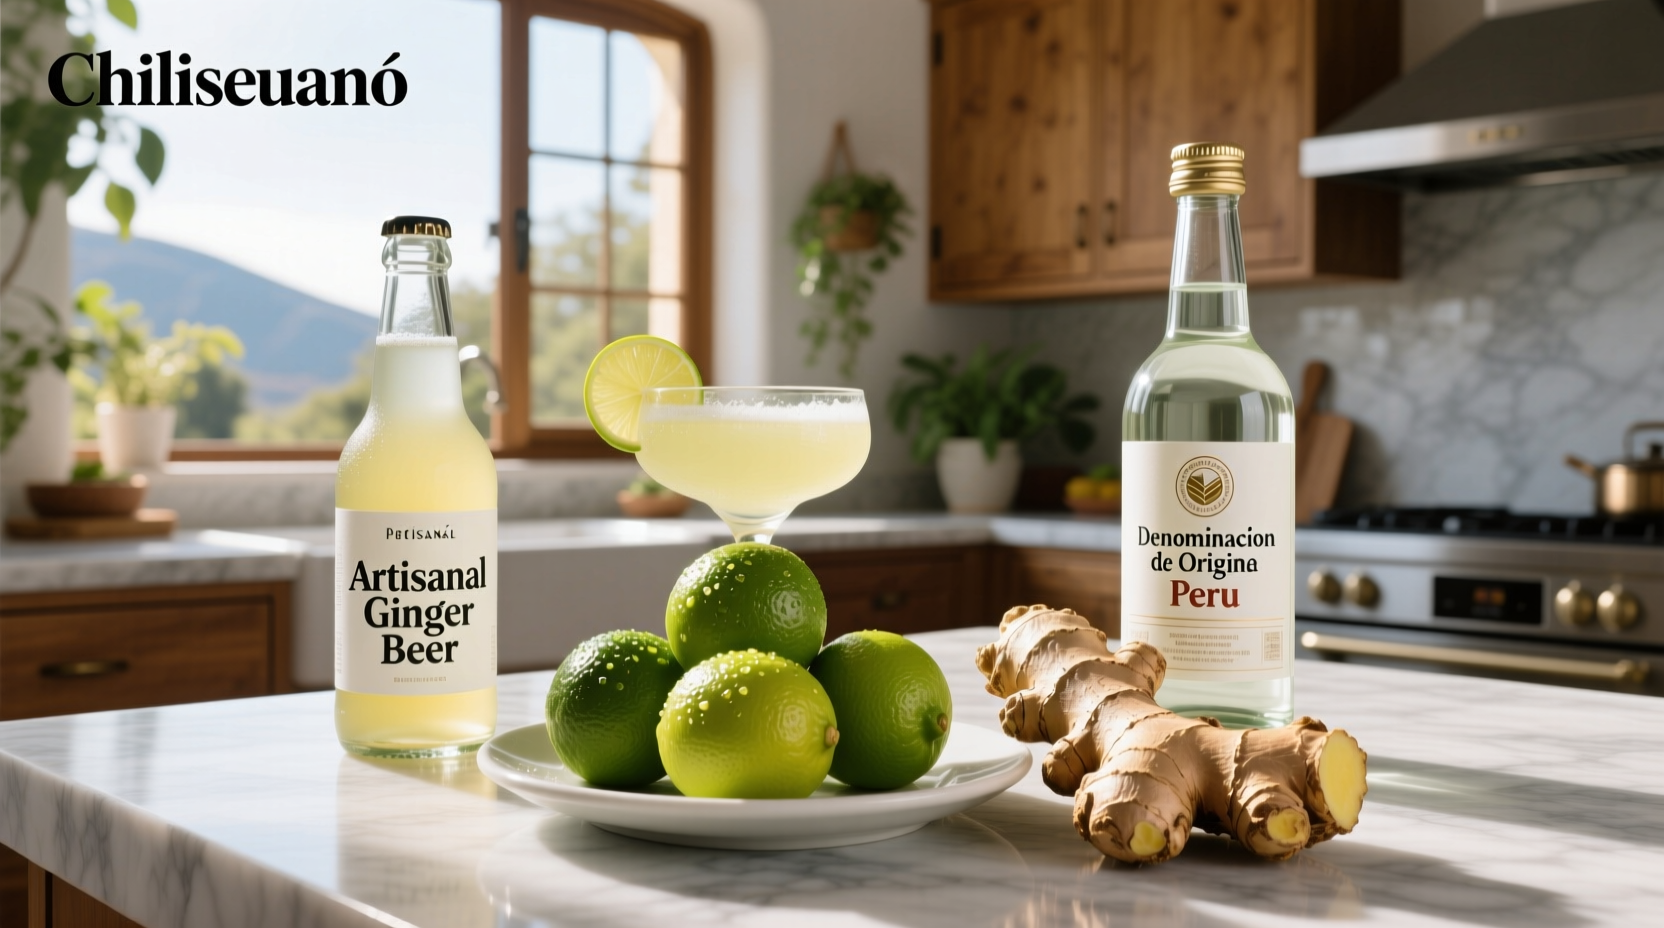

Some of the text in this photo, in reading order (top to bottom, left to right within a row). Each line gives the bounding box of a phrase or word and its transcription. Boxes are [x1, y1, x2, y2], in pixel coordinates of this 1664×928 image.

[1138, 526, 1275, 548] Denominacion
[349, 556, 486, 592] Artisanal
[1151, 552, 1173, 572] de
[1170, 580, 1240, 608] Peru
[364, 596, 474, 637] Ginger
[381, 634, 459, 665] Beer
